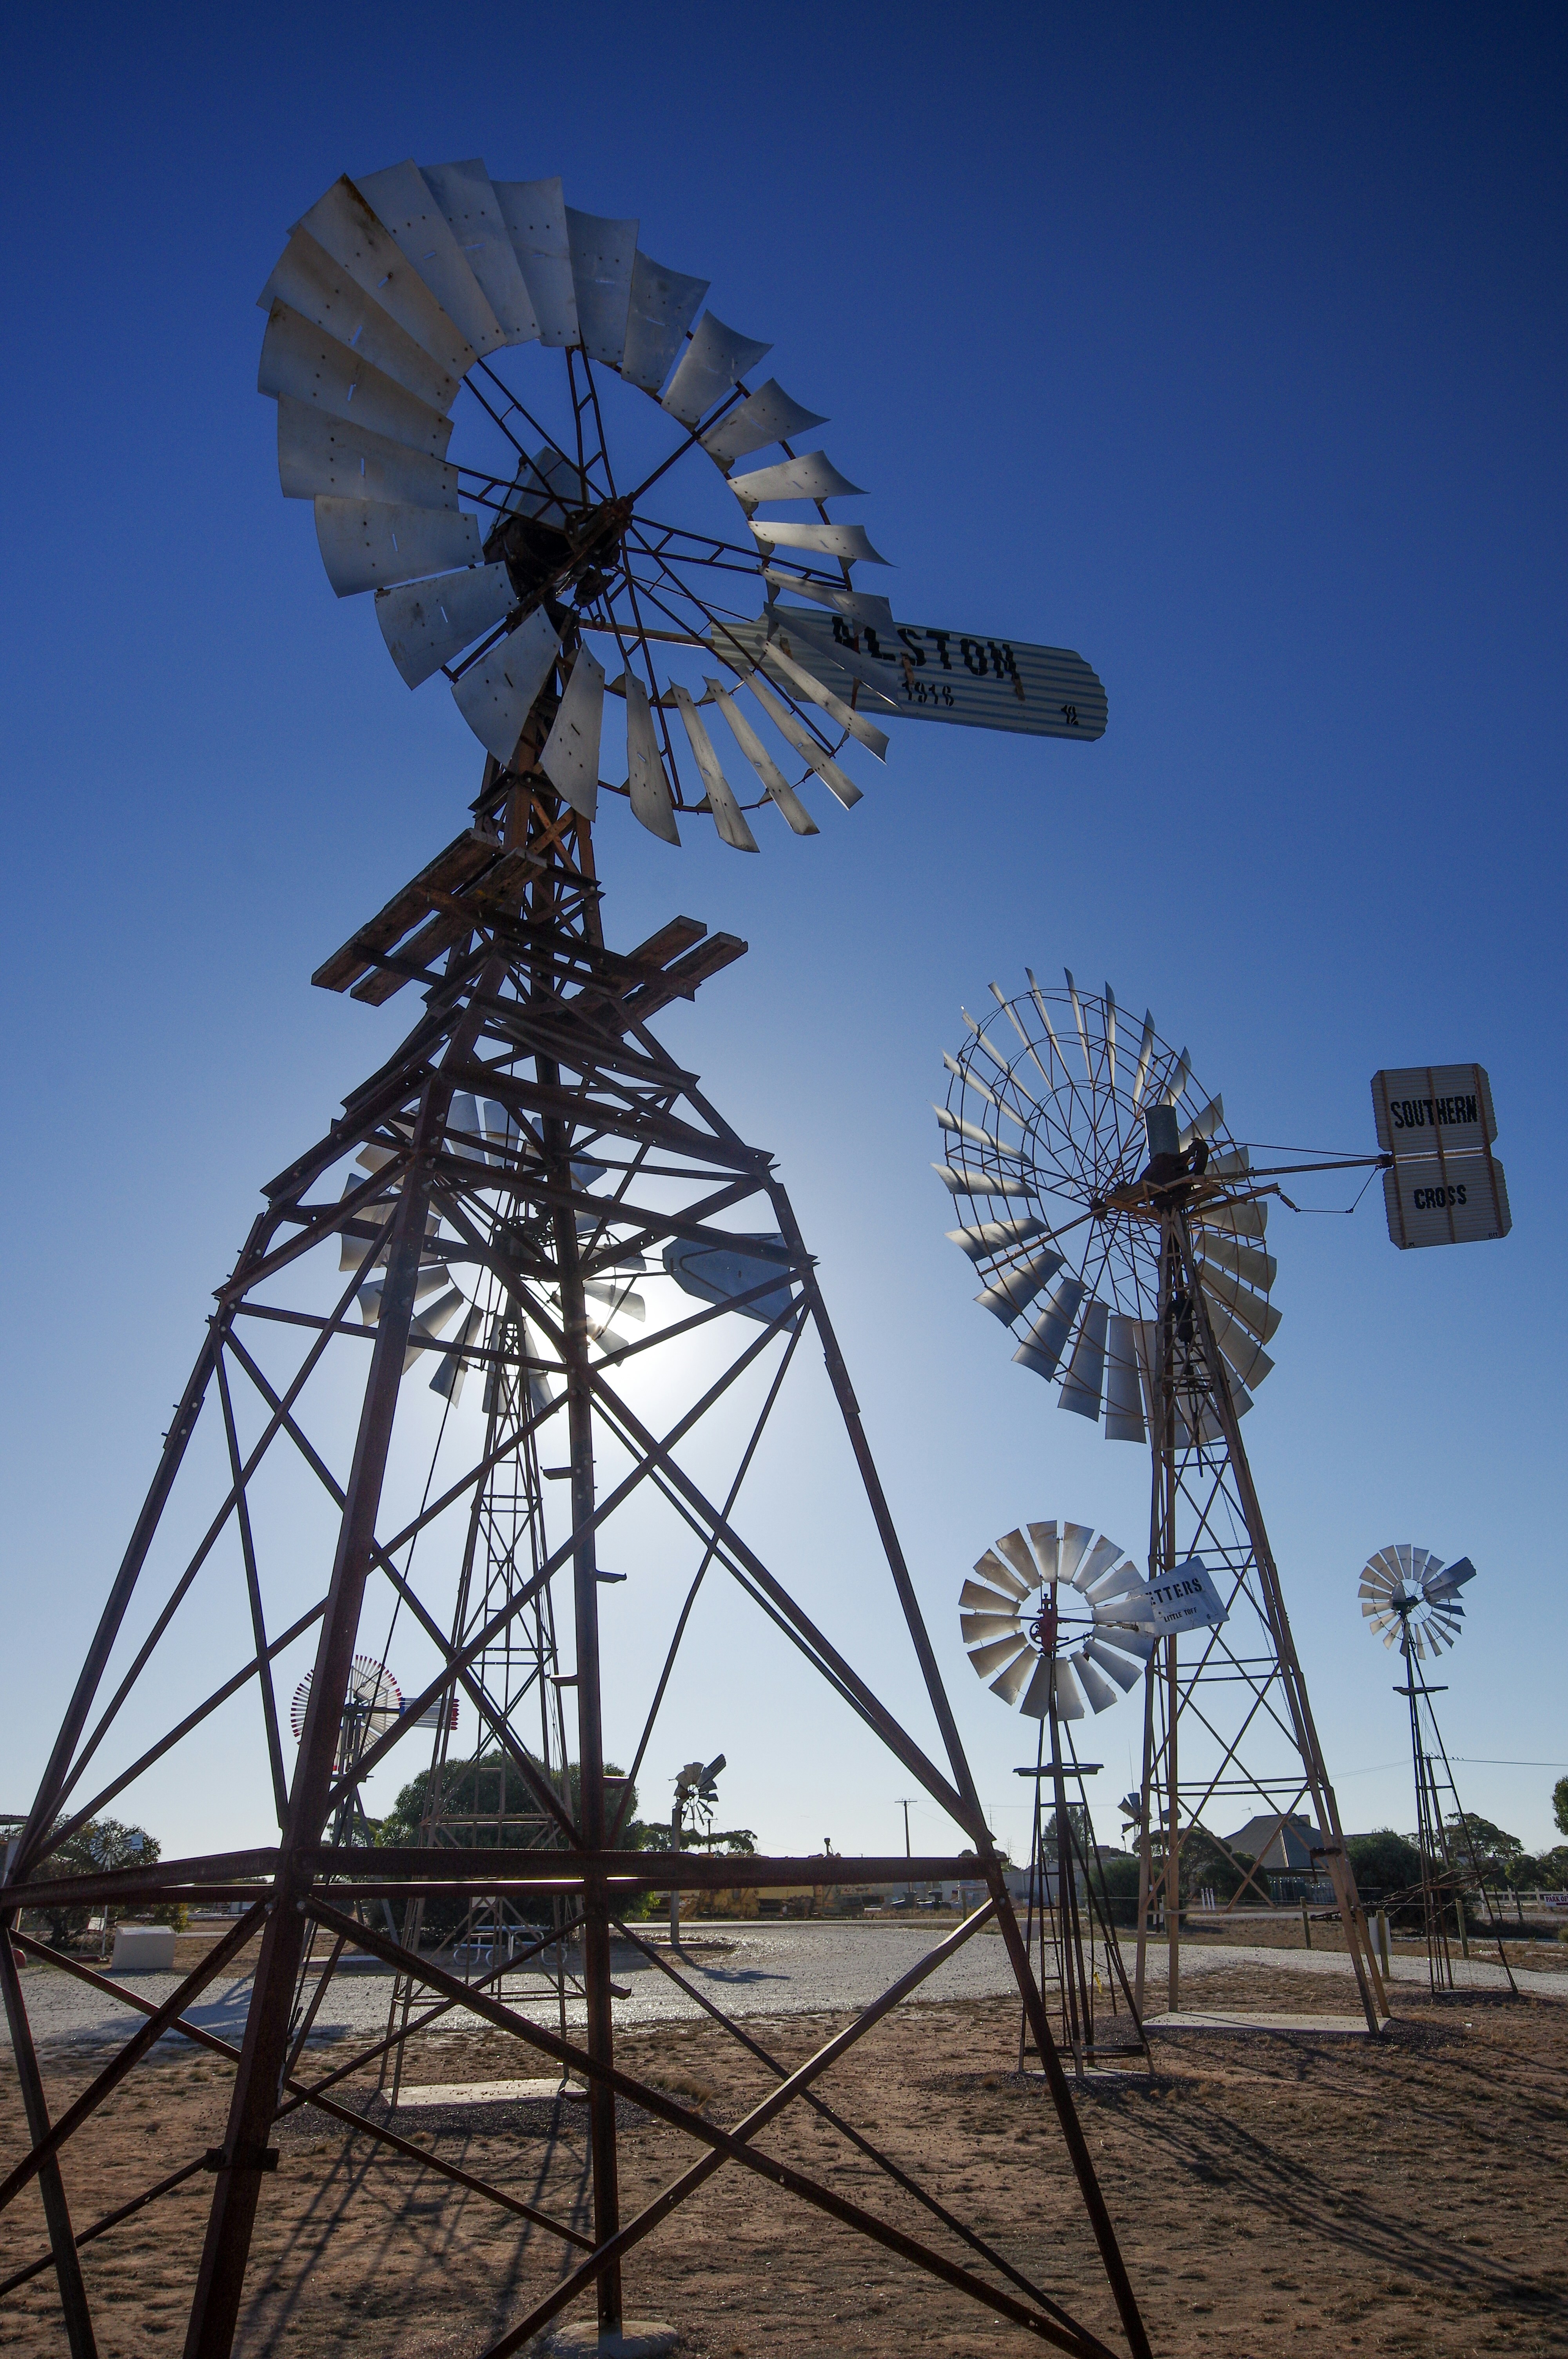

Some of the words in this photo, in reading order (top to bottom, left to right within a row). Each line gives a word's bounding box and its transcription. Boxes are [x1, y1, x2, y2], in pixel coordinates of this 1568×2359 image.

[832, 616, 1020, 680] ALSTON
[1061, 704, 1079, 725] 12
[1390, 1095, 1477, 1129] SOUTHERN
[1414, 1184, 1467, 1210] CROSS
[1164, 1612, 1183, 1623] LITTLE
[1184, 1607, 1197, 1616] TOFF
